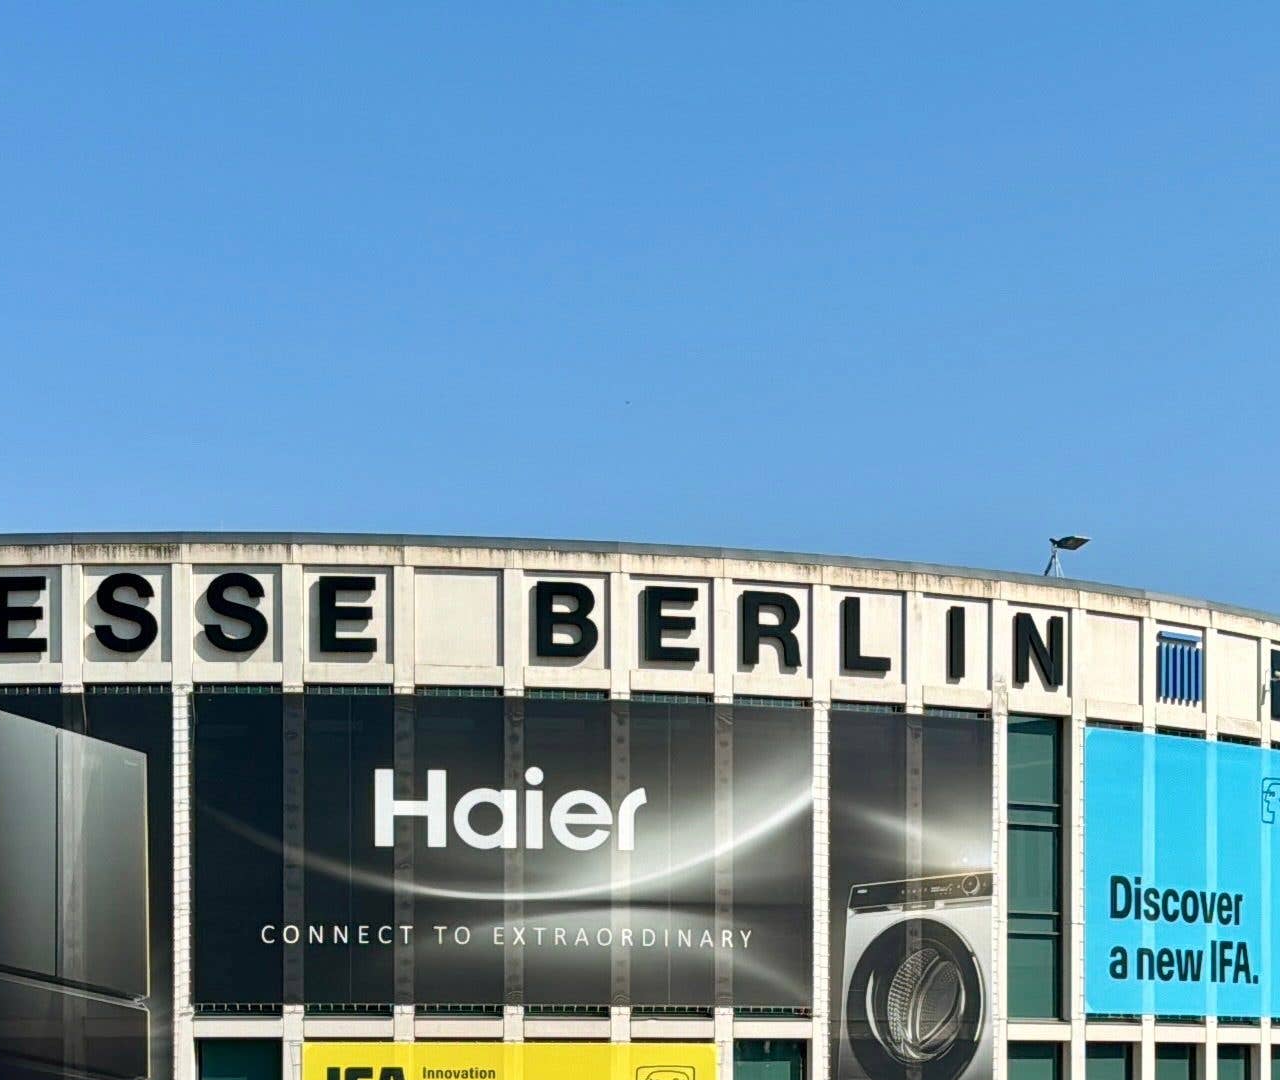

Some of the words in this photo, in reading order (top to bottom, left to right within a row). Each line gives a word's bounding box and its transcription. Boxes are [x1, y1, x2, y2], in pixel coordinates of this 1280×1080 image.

[536, 581, 1063, 686] BERLIN
[374, 766, 648, 851] Haier
[1109, 875, 1243, 926] Discover
[261, 924, 414, 945] CONNECT
[434, 925, 471, 945] TO
[494, 926, 753, 949] EXTRAORDINARY
[1109, 945, 1128, 980] a
[1136, 946, 1203, 982] new
[1210, 940, 1259, 984] IFA.
[422, 1066, 496, 1080] Innovation
